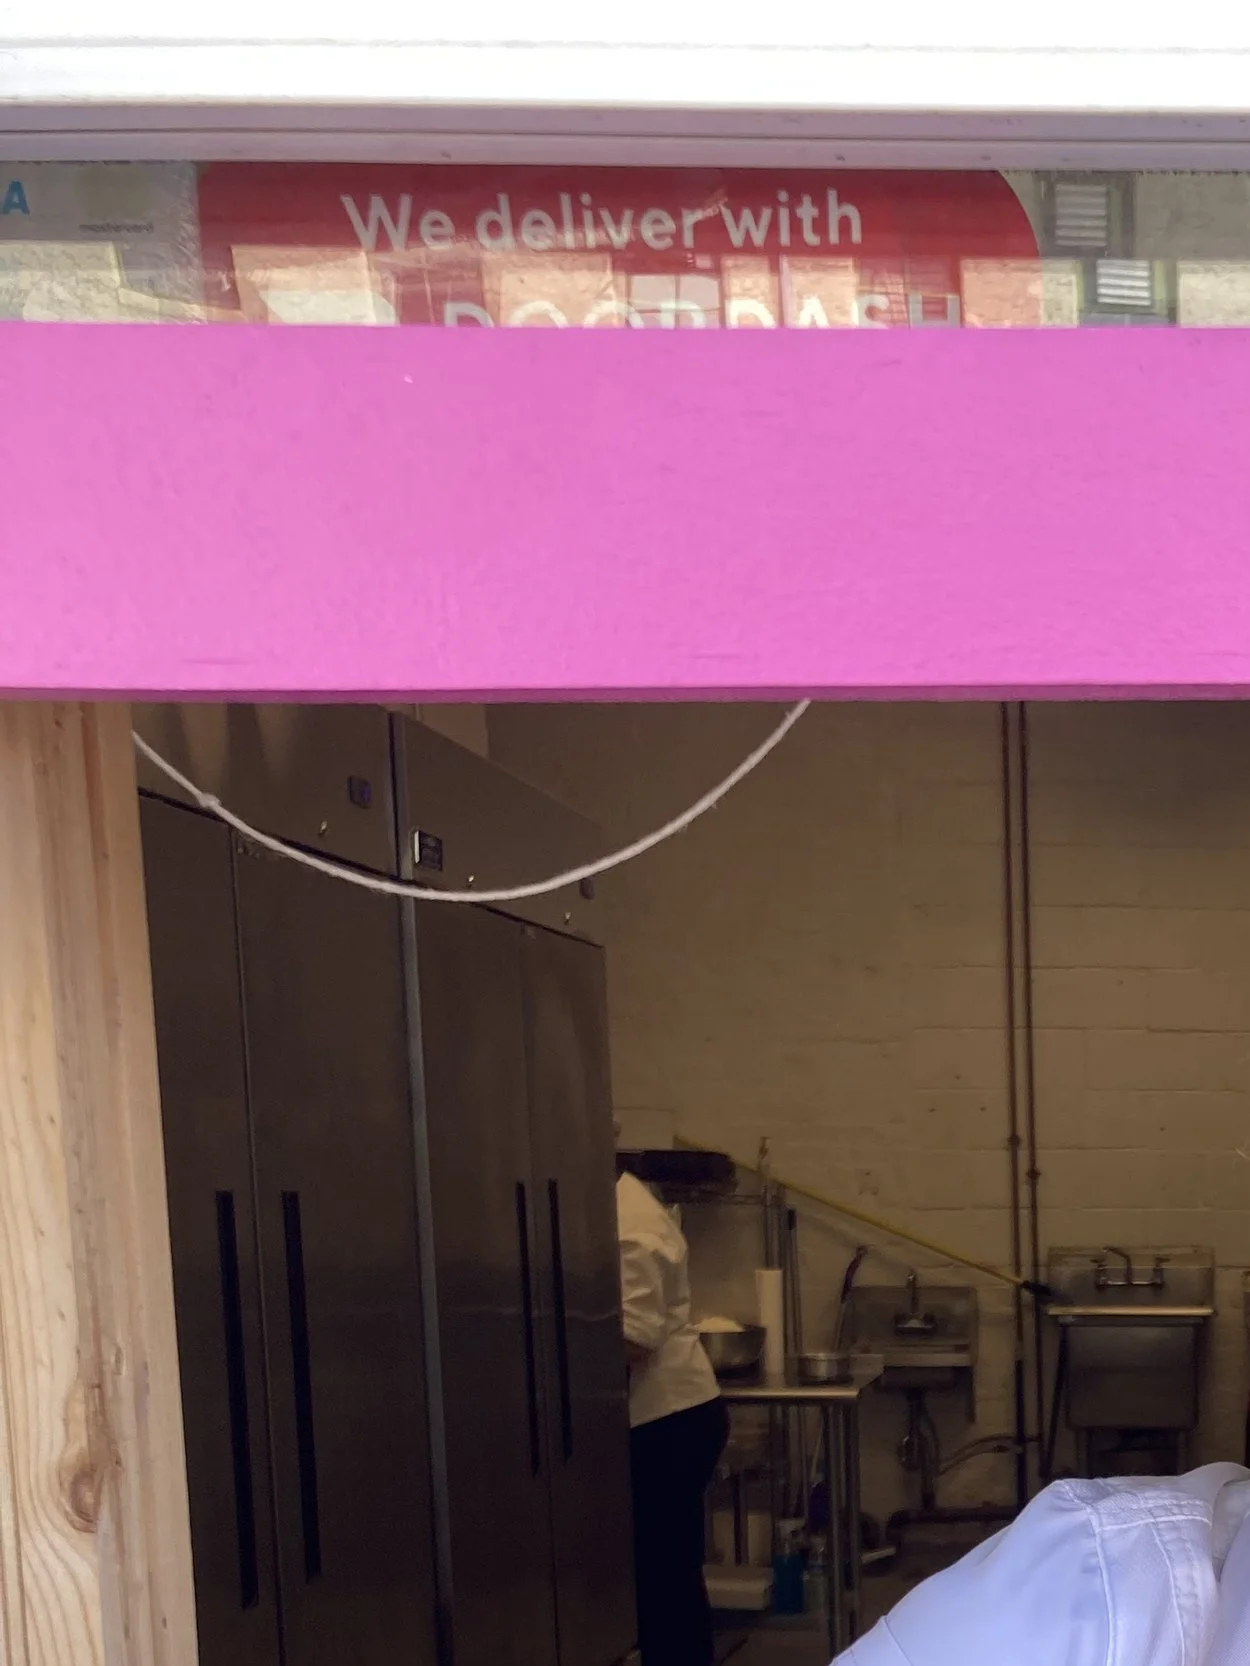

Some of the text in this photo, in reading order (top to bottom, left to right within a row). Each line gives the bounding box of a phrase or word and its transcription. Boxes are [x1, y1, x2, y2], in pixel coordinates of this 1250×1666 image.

[339, 187, 862, 251] We deliver with
